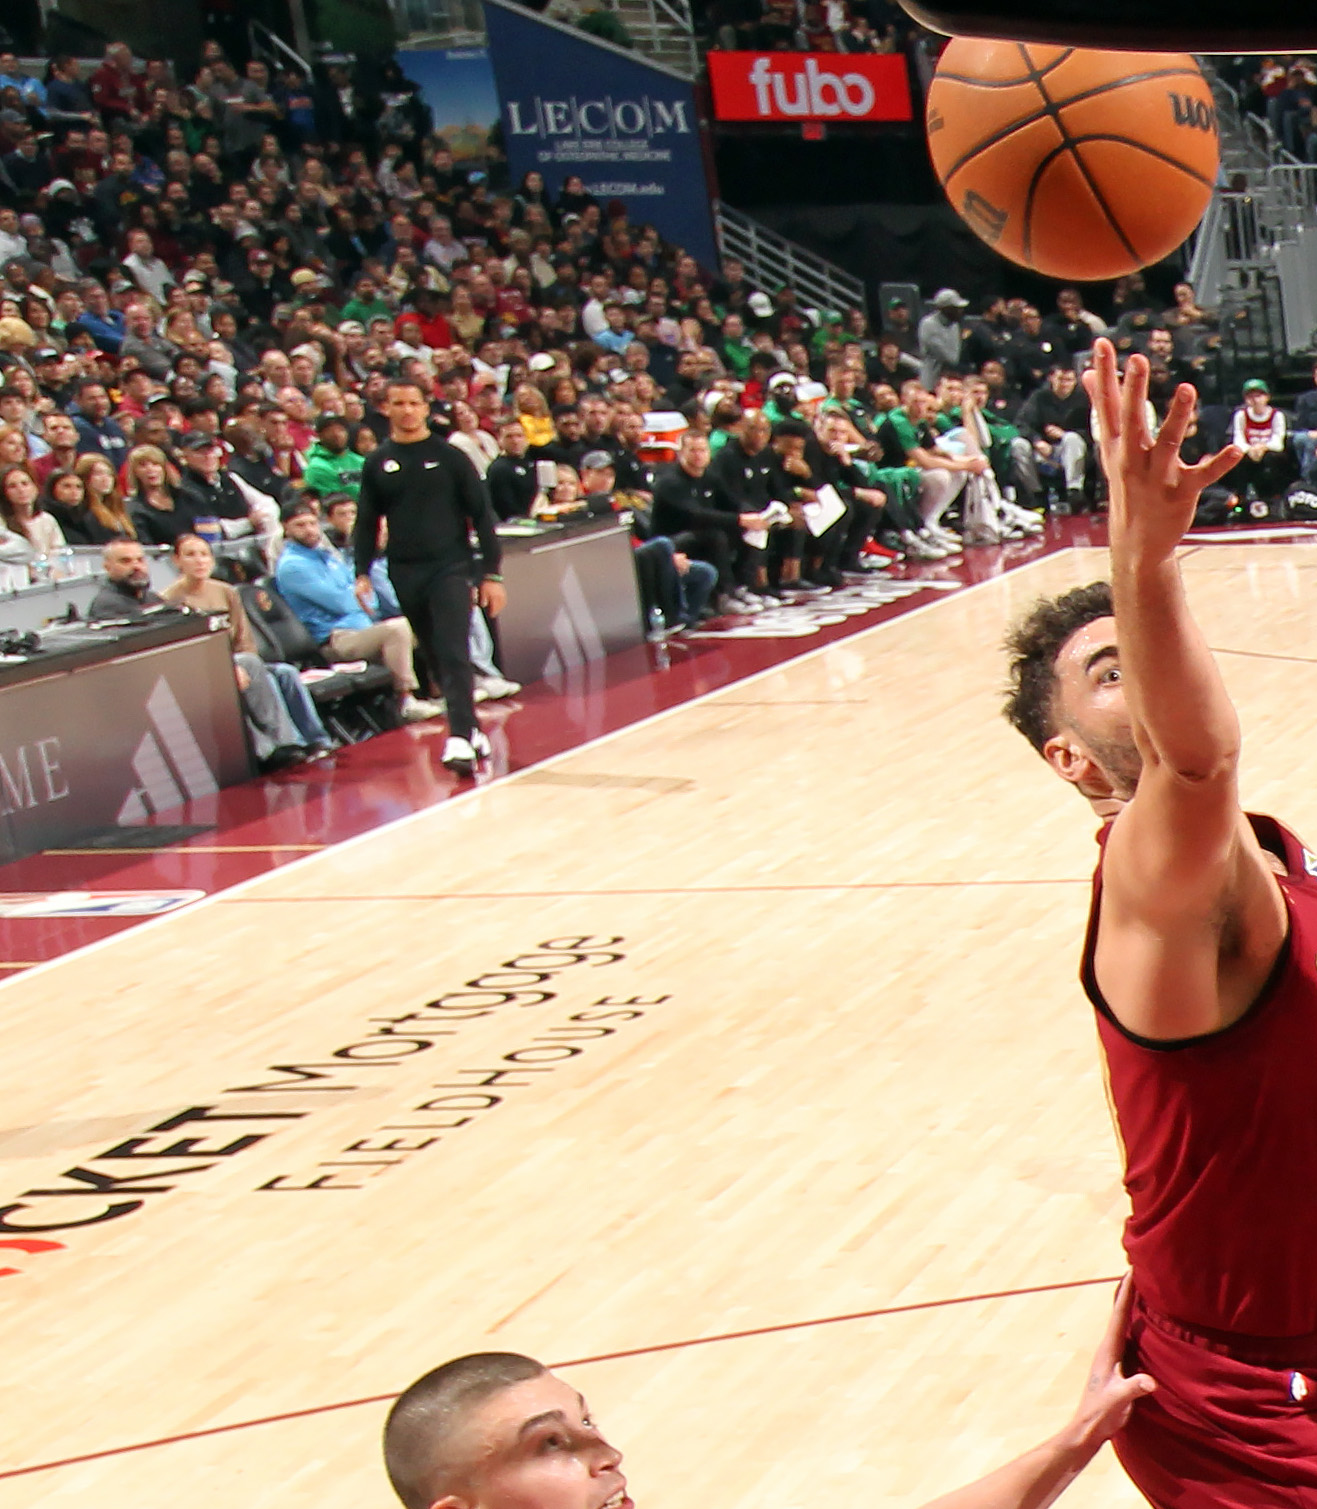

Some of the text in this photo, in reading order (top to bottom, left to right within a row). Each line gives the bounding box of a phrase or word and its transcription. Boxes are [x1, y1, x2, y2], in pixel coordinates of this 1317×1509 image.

[749, 56, 875, 116] fubo
[221, 935, 626, 1093] Mortgage
[253, 993, 674, 1192] FIELDHOUSE
